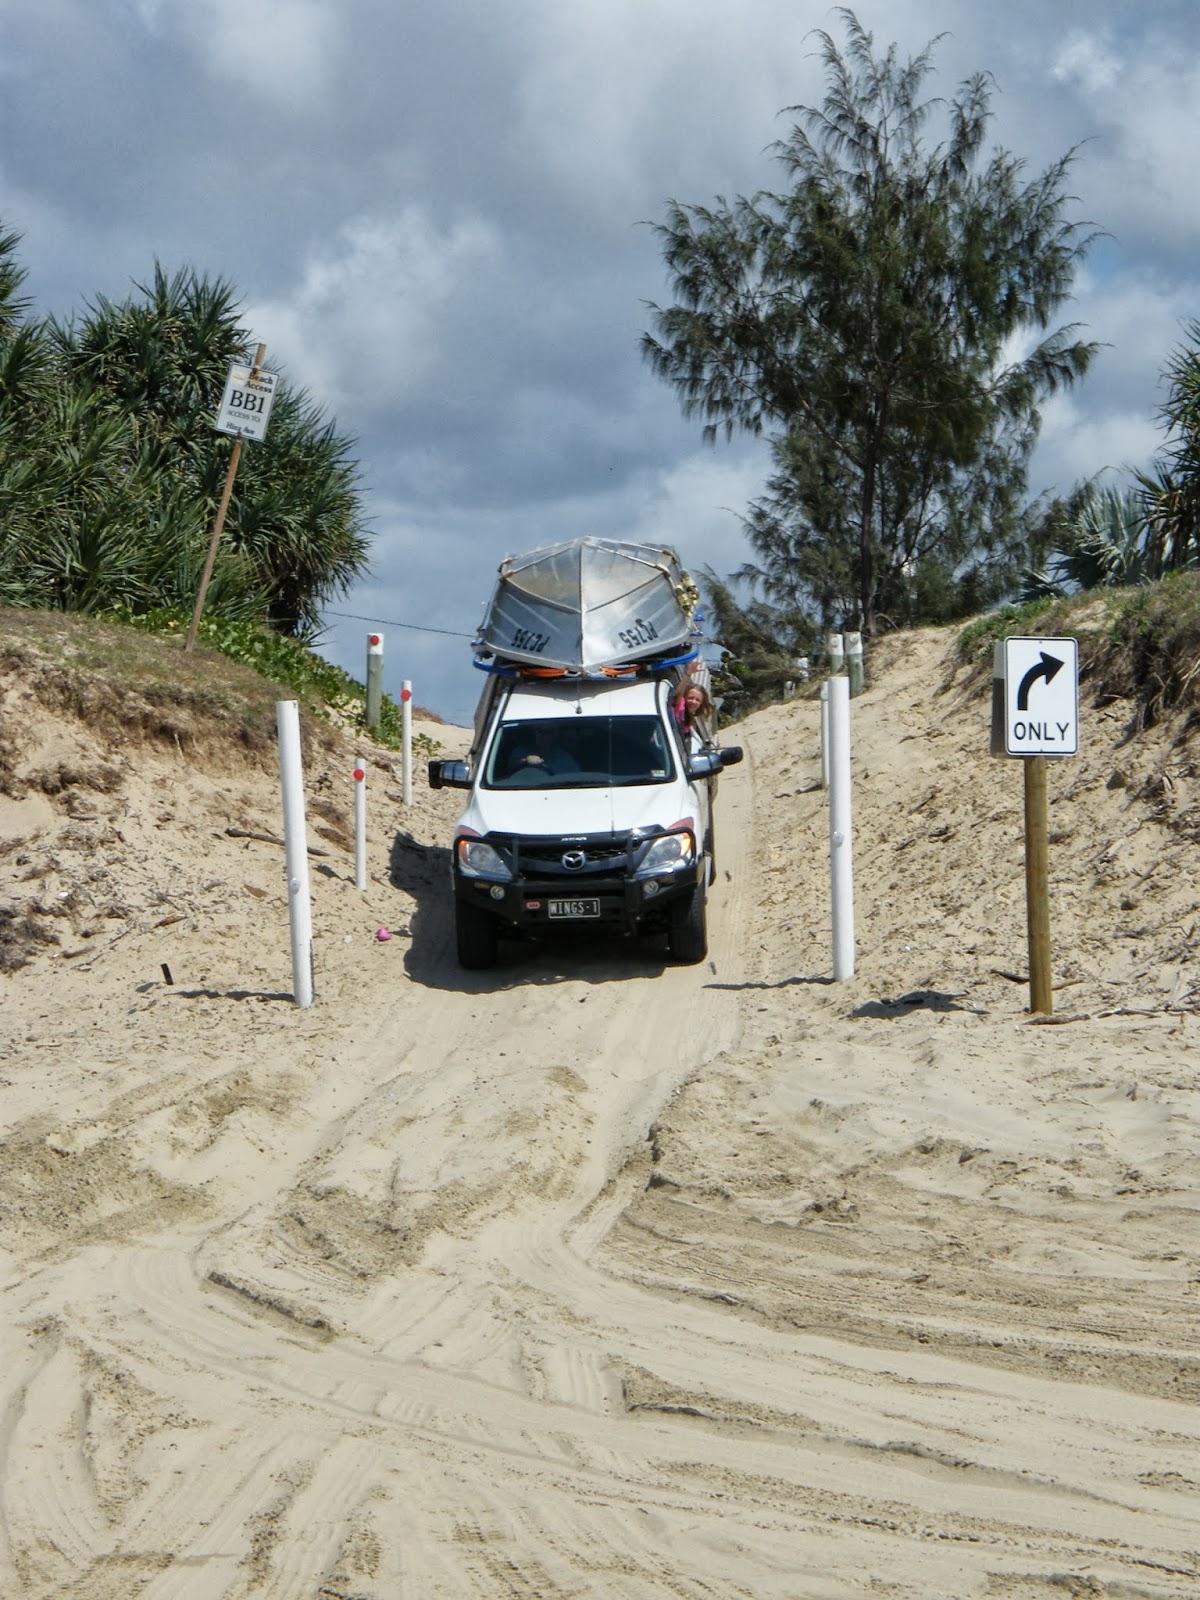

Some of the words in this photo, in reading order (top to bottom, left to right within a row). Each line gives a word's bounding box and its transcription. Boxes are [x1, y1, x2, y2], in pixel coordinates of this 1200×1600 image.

[244, 380, 272, 393] Access
[229, 389, 265, 413] BB1
[227, 409, 250, 420] ACCESS
[511, 628, 550, 653] PC755
[618, 620, 659, 649] PC755
[1014, 722, 1069, 741] ONLY
